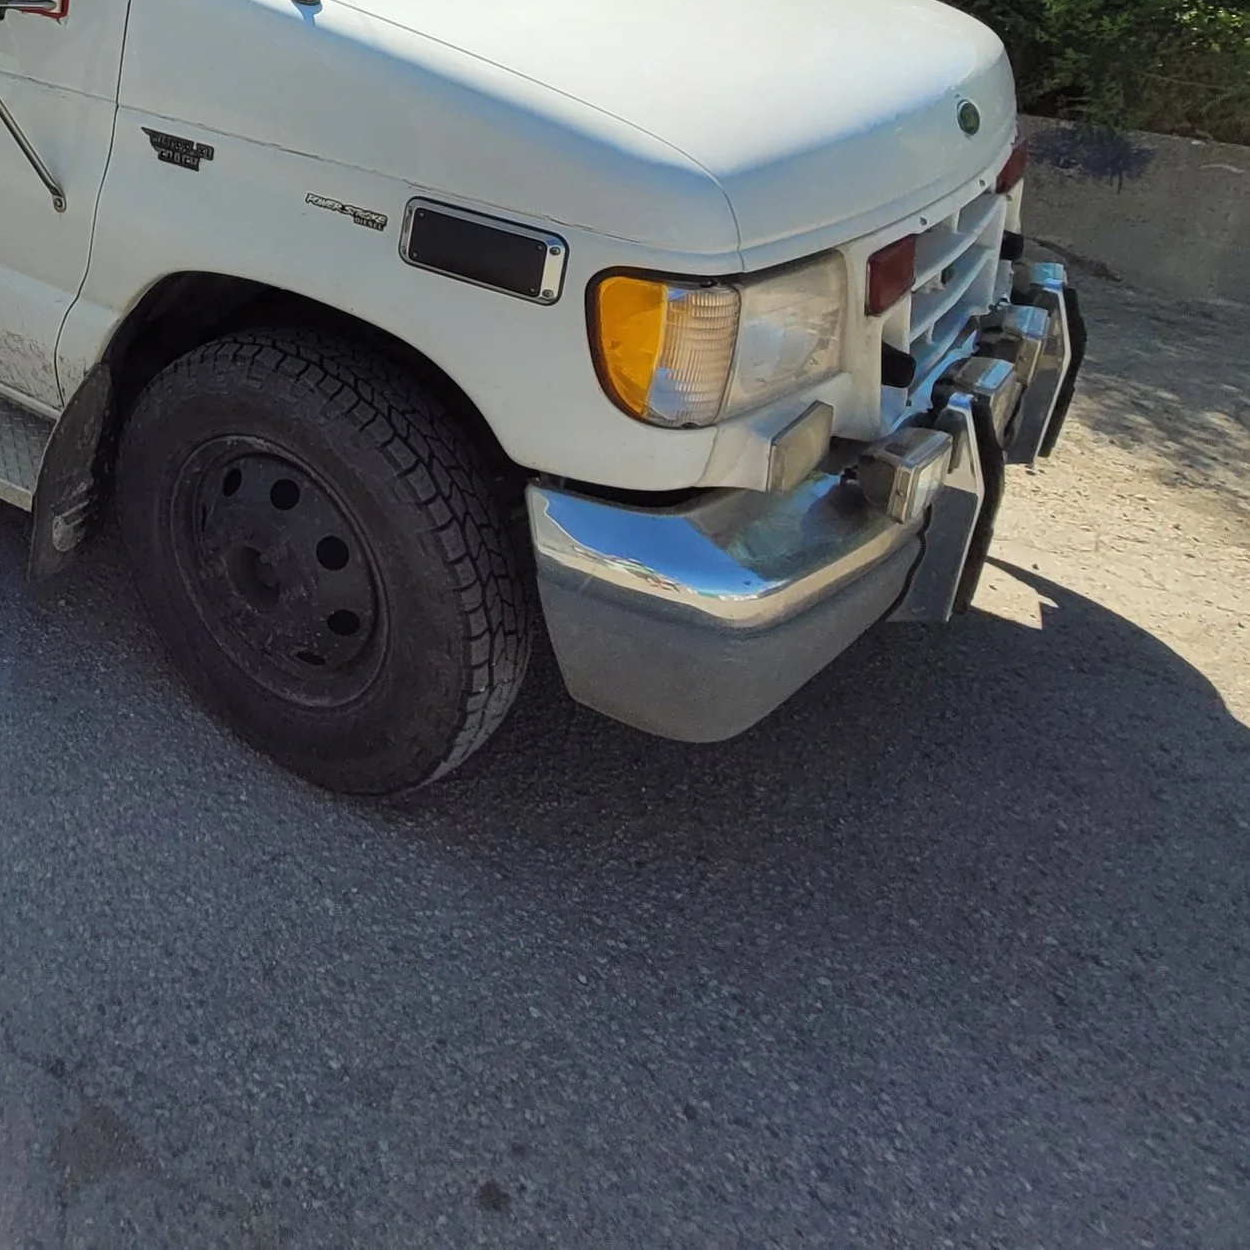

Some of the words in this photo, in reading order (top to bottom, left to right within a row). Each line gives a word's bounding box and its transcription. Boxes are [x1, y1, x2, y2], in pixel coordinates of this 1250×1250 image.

[306, 194, 343, 211] POWER
[343, 206, 387, 224] STROKE
[354, 216, 385, 231] DIESEL
